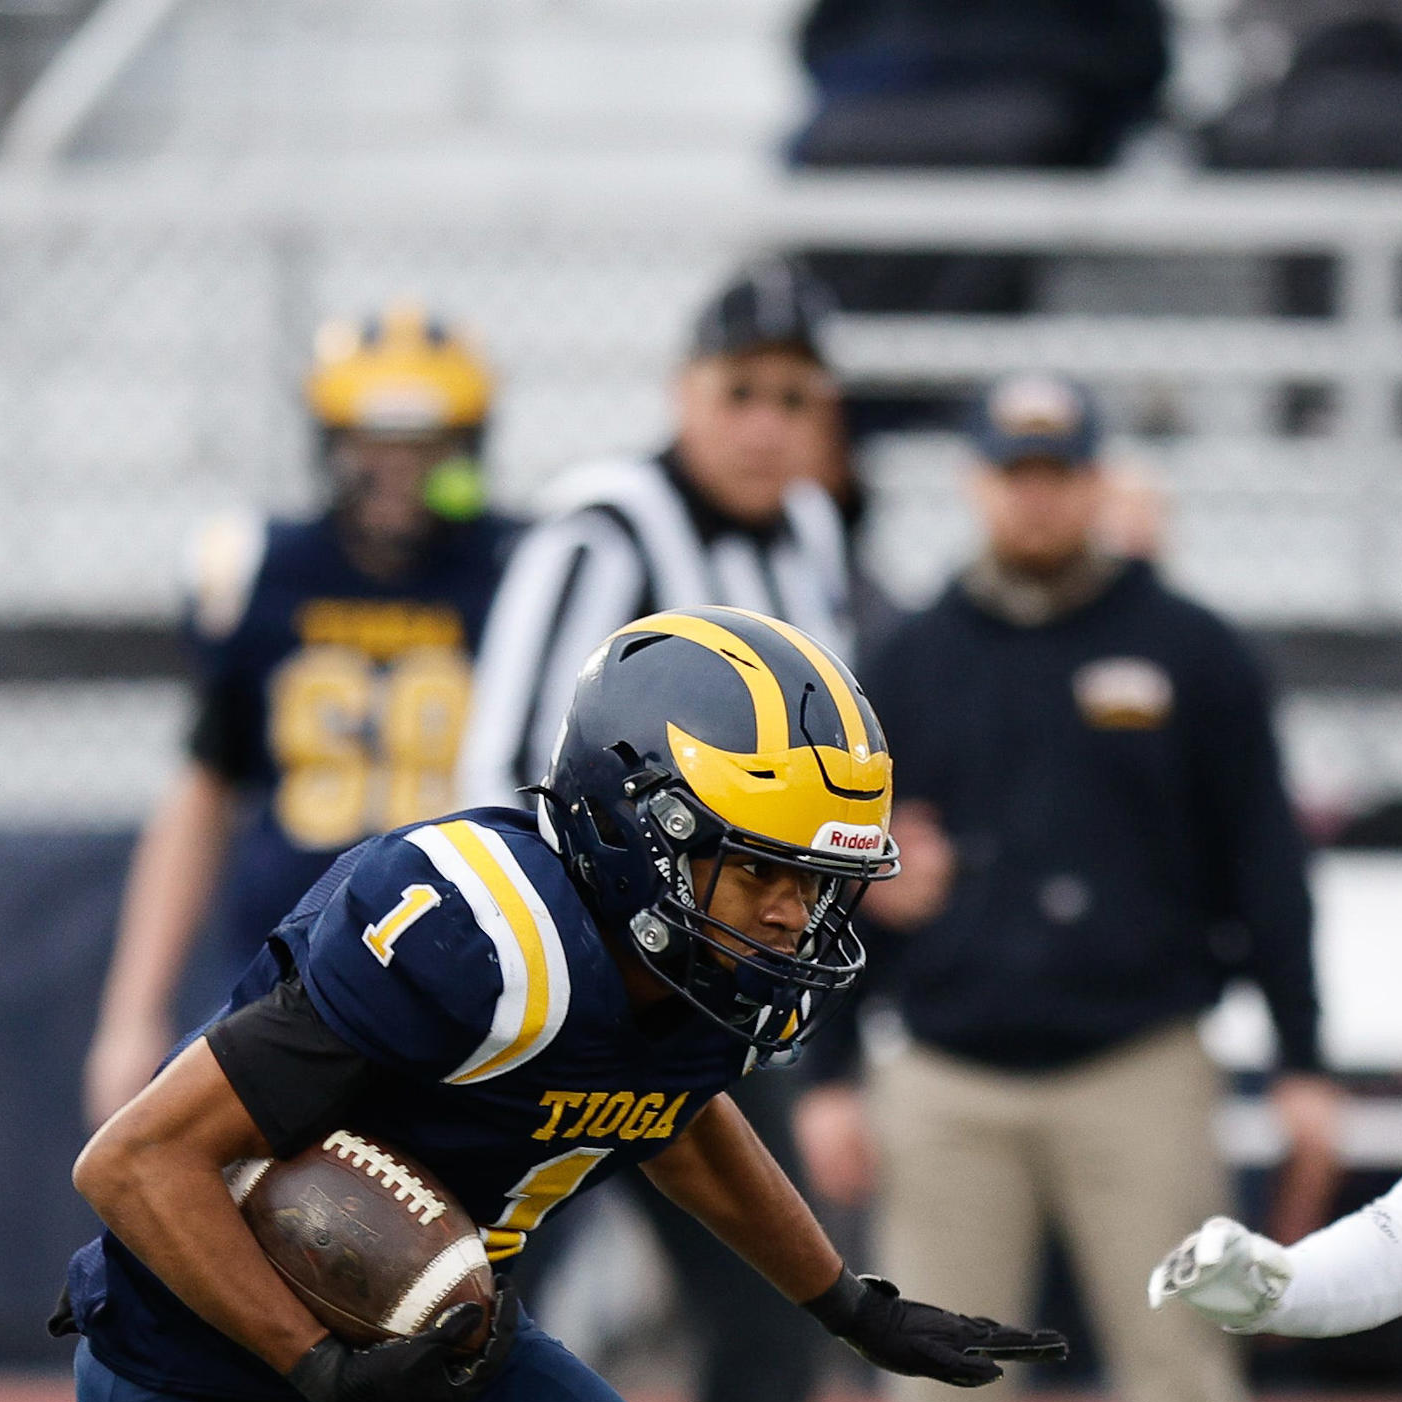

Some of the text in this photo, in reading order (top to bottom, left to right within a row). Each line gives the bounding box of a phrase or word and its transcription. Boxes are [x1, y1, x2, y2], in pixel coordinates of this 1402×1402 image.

[829, 829, 881, 850] Riddell
[361, 884, 443, 968] 1
[531, 1090, 690, 1141] TIOGA
[478, 1146, 615, 1262] 1
